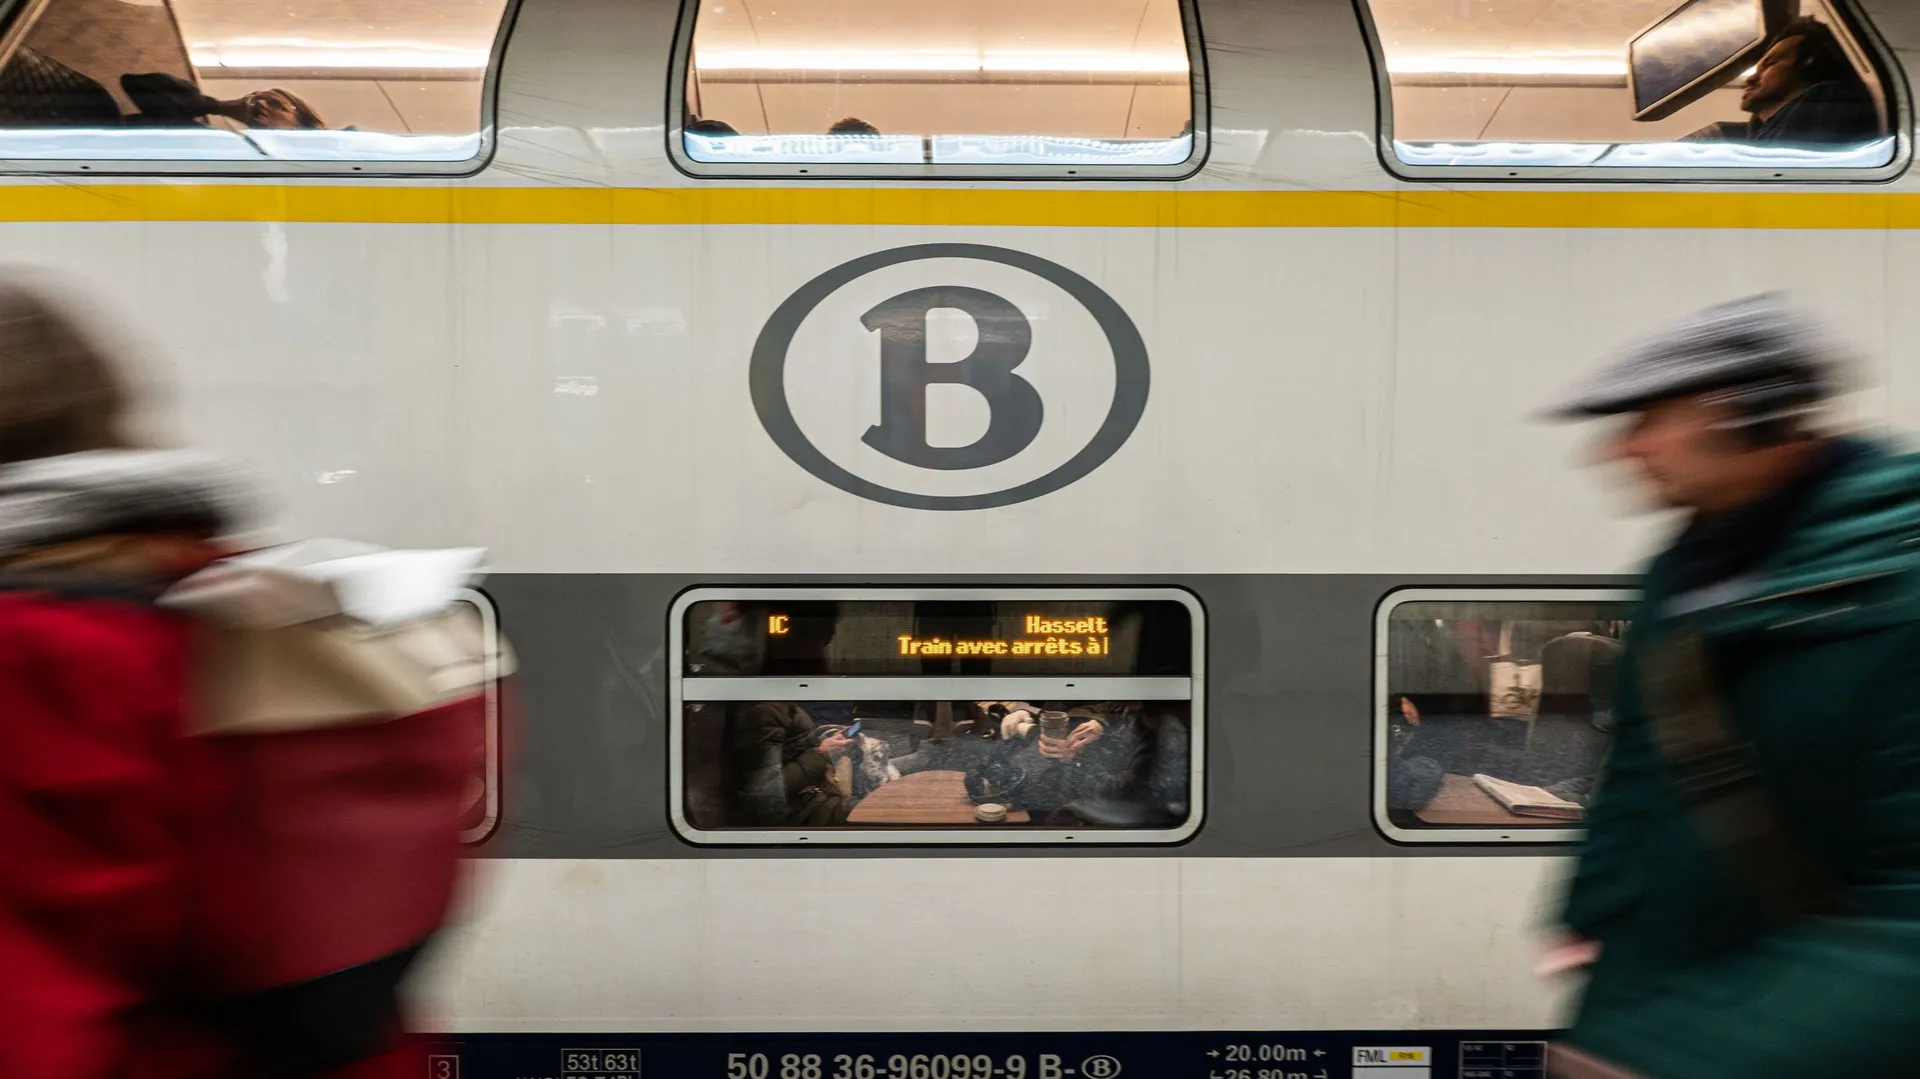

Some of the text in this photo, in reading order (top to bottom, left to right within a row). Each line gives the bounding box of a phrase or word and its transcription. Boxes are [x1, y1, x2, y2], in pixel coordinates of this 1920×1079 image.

[859, 285, 1044, 471] B
[768, 616, 789, 634] IC
[1026, 616, 1108, 634] Hasselt
[898, 637, 953, 655] Train
[956, 641, 1008, 655] avec
[1011, 637, 1083, 655] arrêts
[1086, 637, 1101, 655] à
[1225, 1044, 1307, 1061] 20.00m
[436, 1060, 450, 1079] 3
[567, 1054, 598, 1070] 53t
[727, 1053, 769, 1079] 50
[780, 1053, 822, 1079] 88
[833, 1054, 1027, 1079] 36-96099-9
